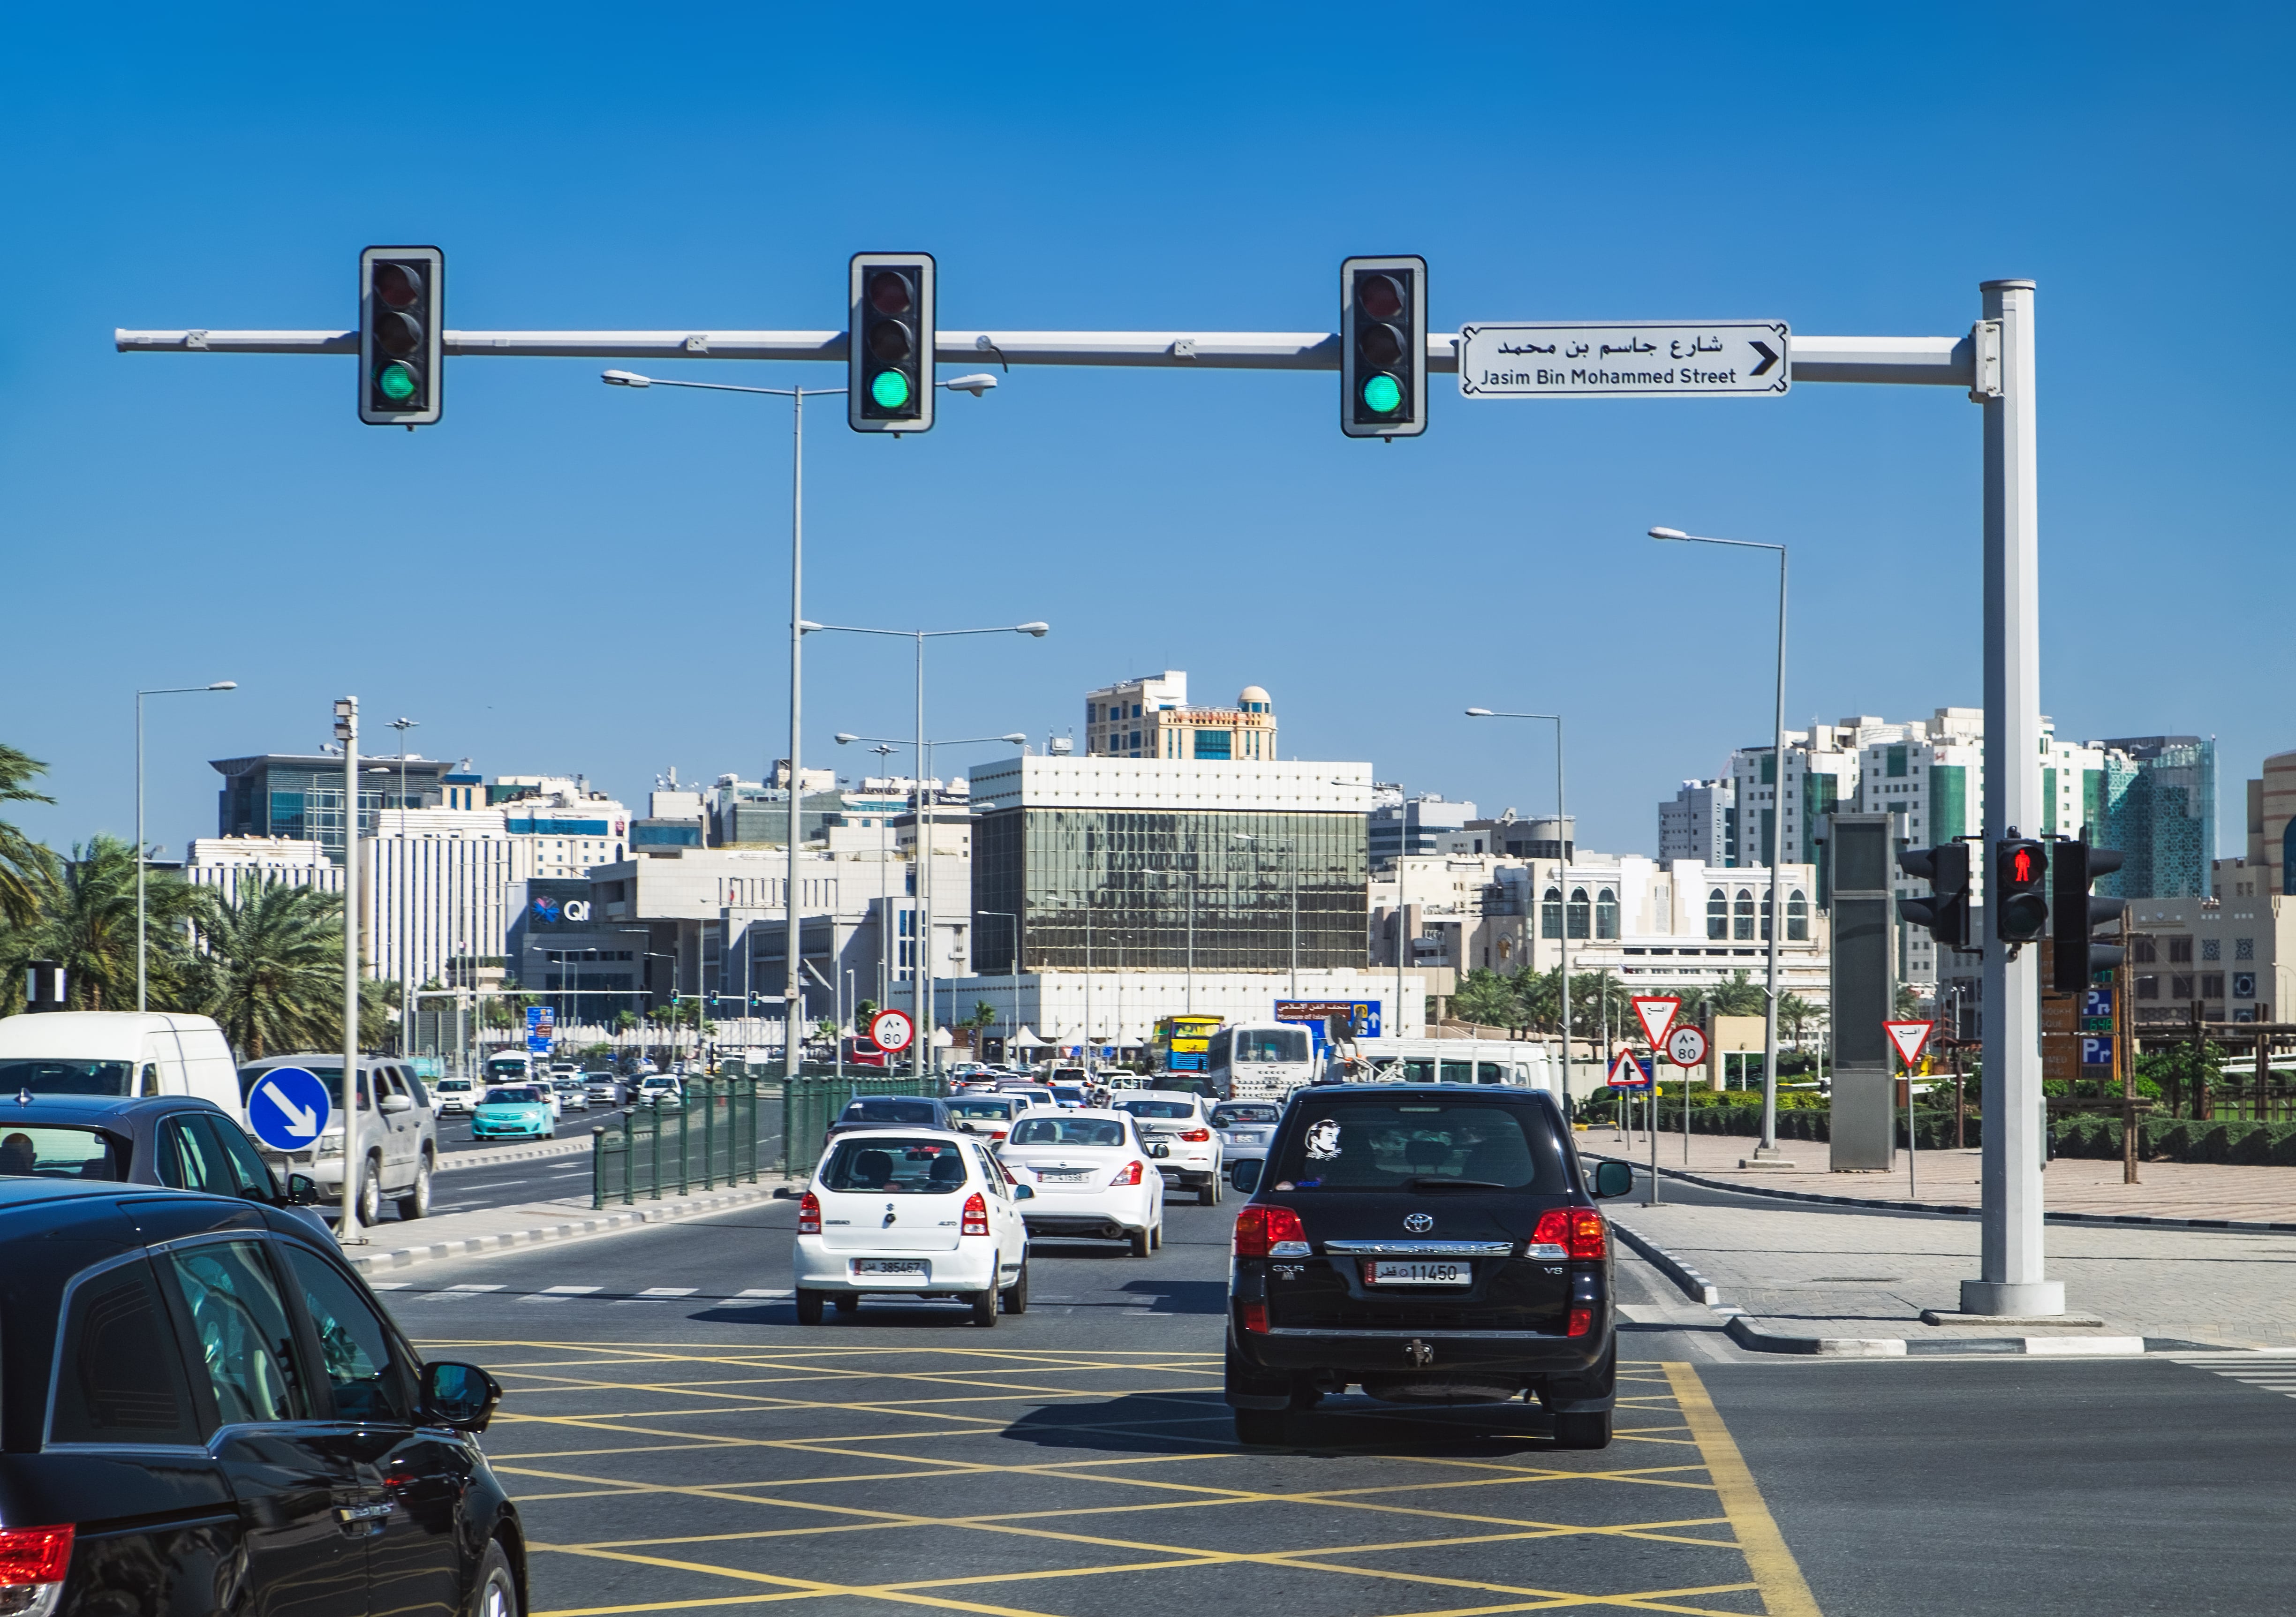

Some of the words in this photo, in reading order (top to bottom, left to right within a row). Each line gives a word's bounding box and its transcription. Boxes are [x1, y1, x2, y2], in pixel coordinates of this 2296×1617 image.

[1498, 341, 1556, 355] محمد
[1565, 340, 1589, 358] بن
[1600, 335, 1657, 360] جاسم
[1670, 335, 1723, 359] شارع
[1480, 369, 1530, 385] Jasim
[1537, 369, 1565, 384] Bin
[1571, 369, 1674, 384] Mohammed
[1680, 368, 1736, 383] Street
[2090, 1018, 2113, 1031] 648
[884, 1033, 901, 1044] 80
[1678, 1048, 1696, 1059] 80
[2083, 1038, 2100, 1063] P
[880, 1262, 921, 1273] 385467
[1376, 1266, 1397, 1279] قطر
[1411, 1265, 1458, 1281] 11450
